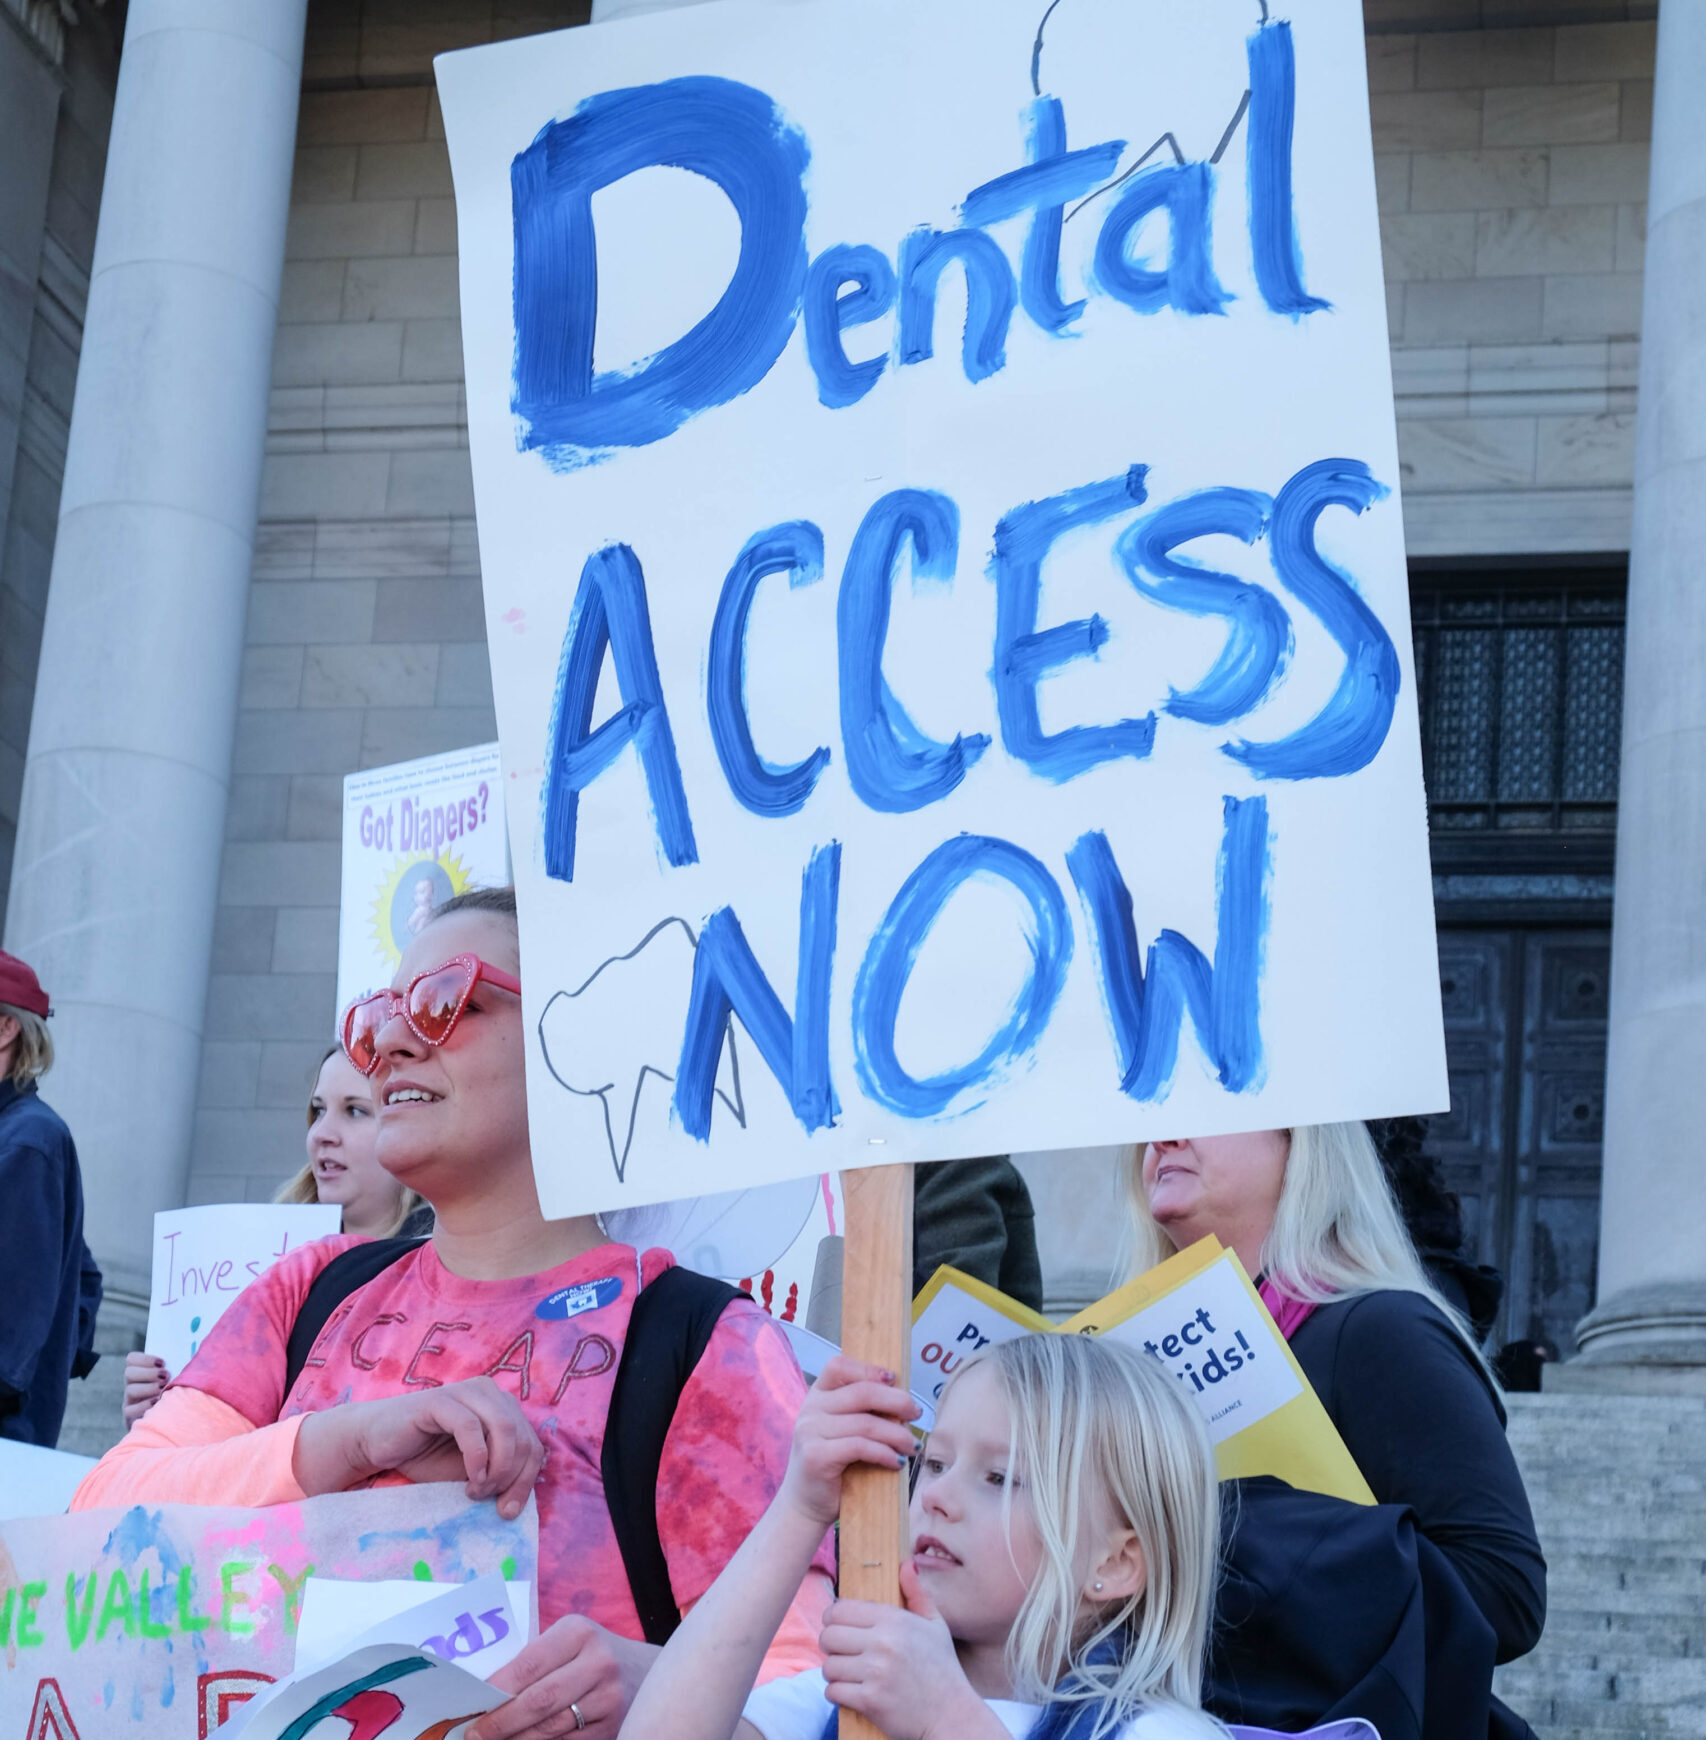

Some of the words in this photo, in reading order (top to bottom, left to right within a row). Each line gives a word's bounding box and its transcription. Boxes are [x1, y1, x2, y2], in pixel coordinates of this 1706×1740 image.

[510, 17, 1335, 474] Dental
[535, 456, 1402, 883] ACCESS
[360, 802, 394, 852] Got
[401, 780, 489, 861] Diapers?
[669, 792, 1277, 1147] NOW
[548, 1287, 580, 1305] DENTAL
[921, 1342, 964, 1375] OU
[956, 1321, 991, 1351] Pr
[1143, 1307, 1217, 1366] tect
[1177, 1330, 1256, 1395] ids!
[1211, 1399, 1244, 1422] ALLIANCE
[65, 1558, 316, 1652] VALLEY
